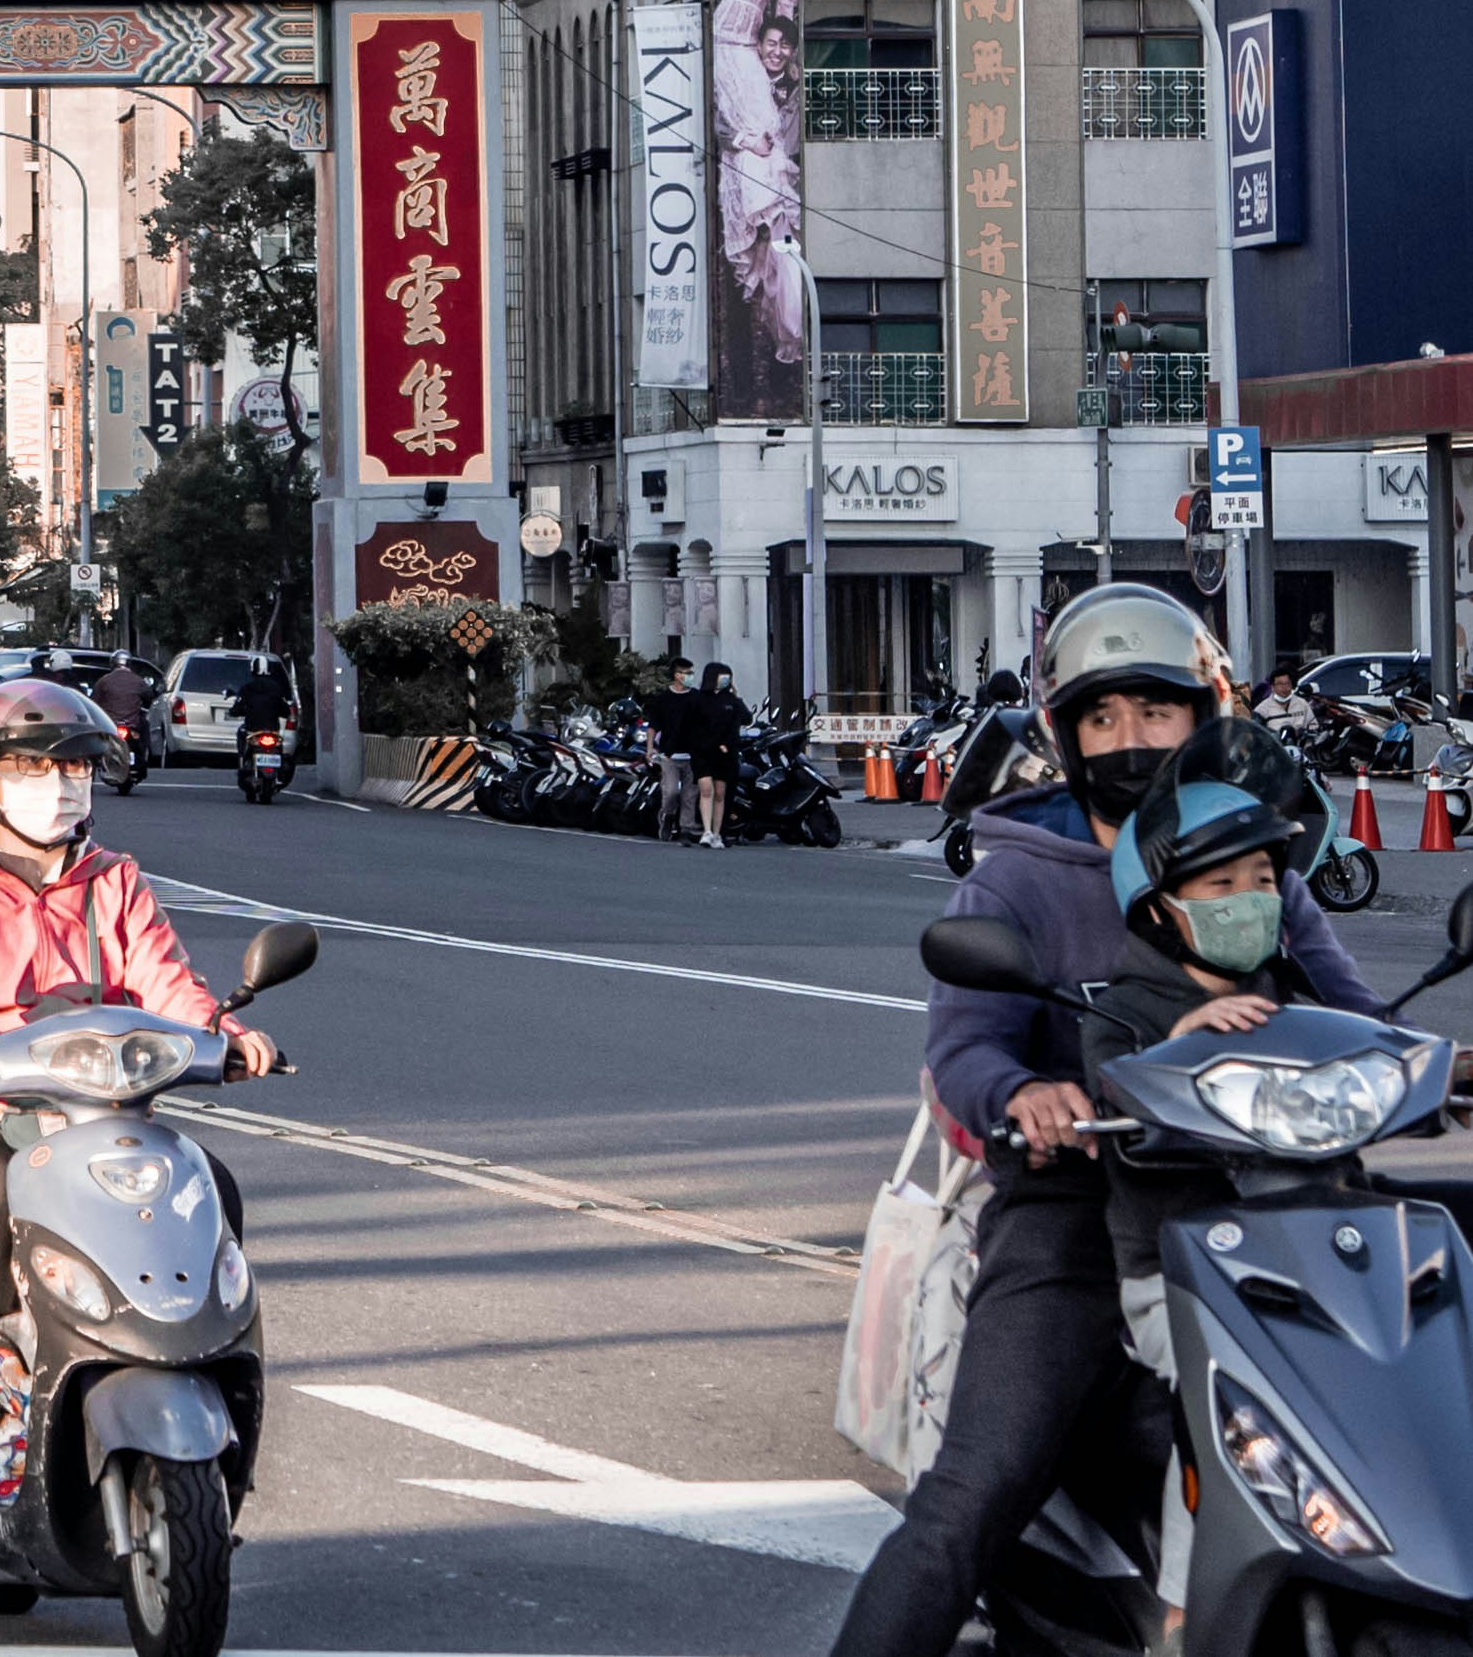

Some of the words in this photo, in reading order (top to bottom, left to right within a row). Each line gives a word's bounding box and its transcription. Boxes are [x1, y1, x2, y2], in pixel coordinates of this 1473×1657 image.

[641, 42, 697, 277] KALOS
[1238, 170, 1268, 228] 全聯
[385, 41, 461, 458] 萬商雲集
[154, 343, 180, 443] TAT2
[1217, 433, 1243, 466] P
[822, 465, 947, 495] KALOS
[1224, 497, 1249, 508] 平面
[1218, 512, 1257, 524] 停車場
